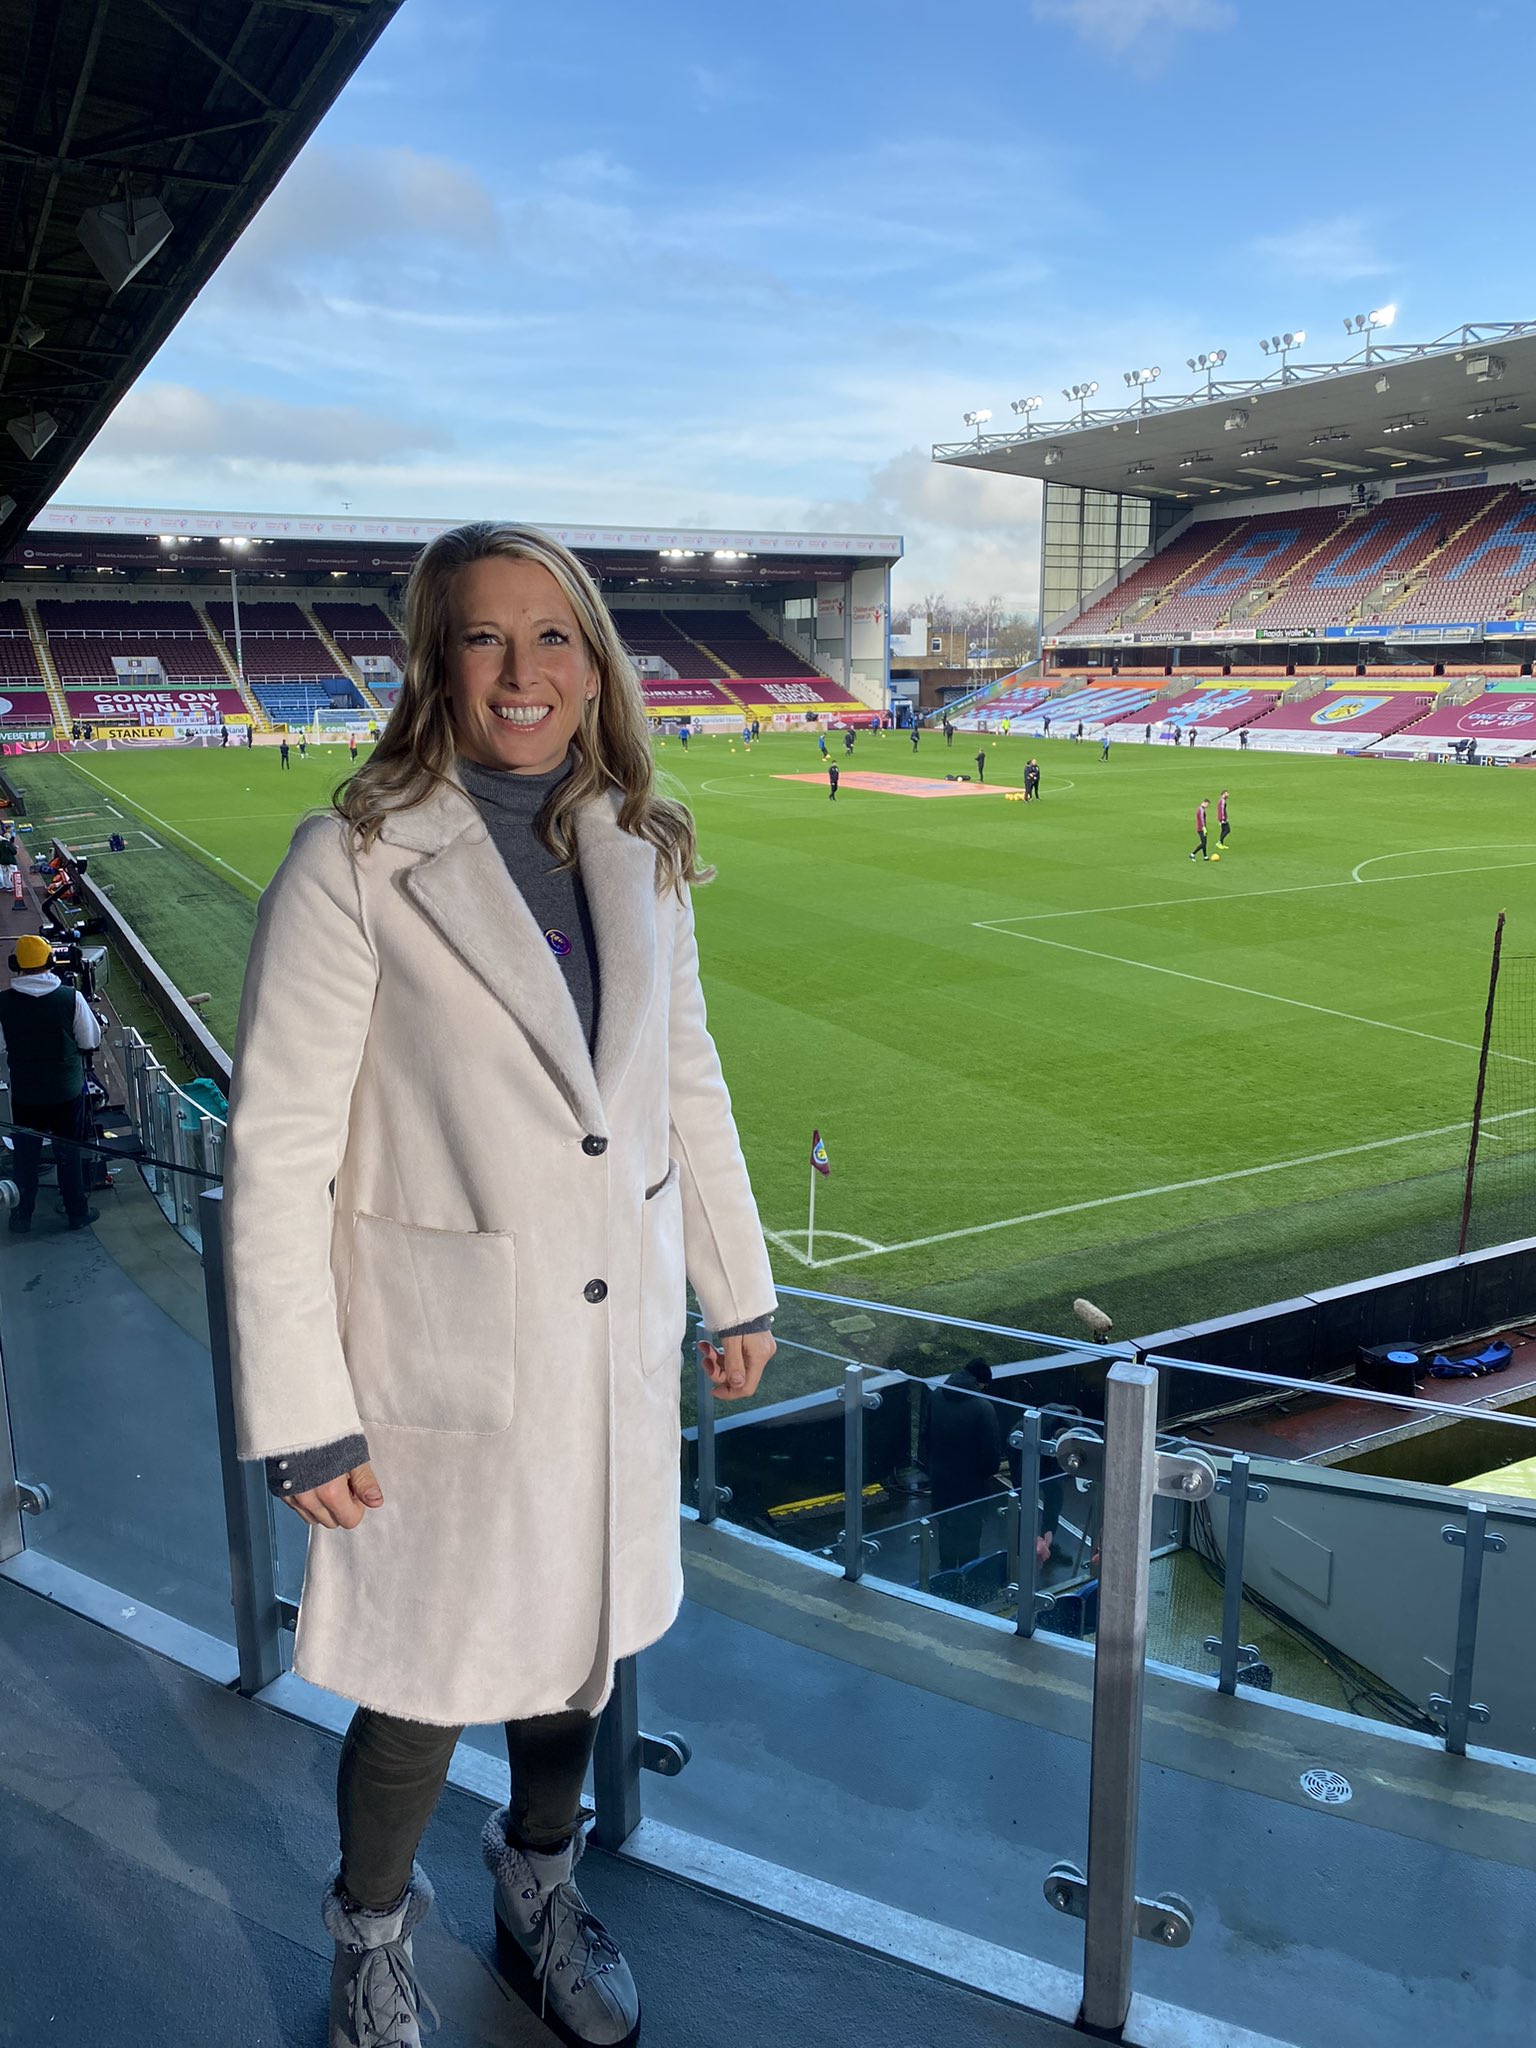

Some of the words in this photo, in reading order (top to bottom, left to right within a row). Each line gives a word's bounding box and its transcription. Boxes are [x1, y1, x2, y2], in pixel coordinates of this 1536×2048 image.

[94, 693, 174, 703] COME
[178, 692, 218, 702] ON
[97, 702, 220, 713] BURNLEY
[109, 728, 164, 738] STANLEY
